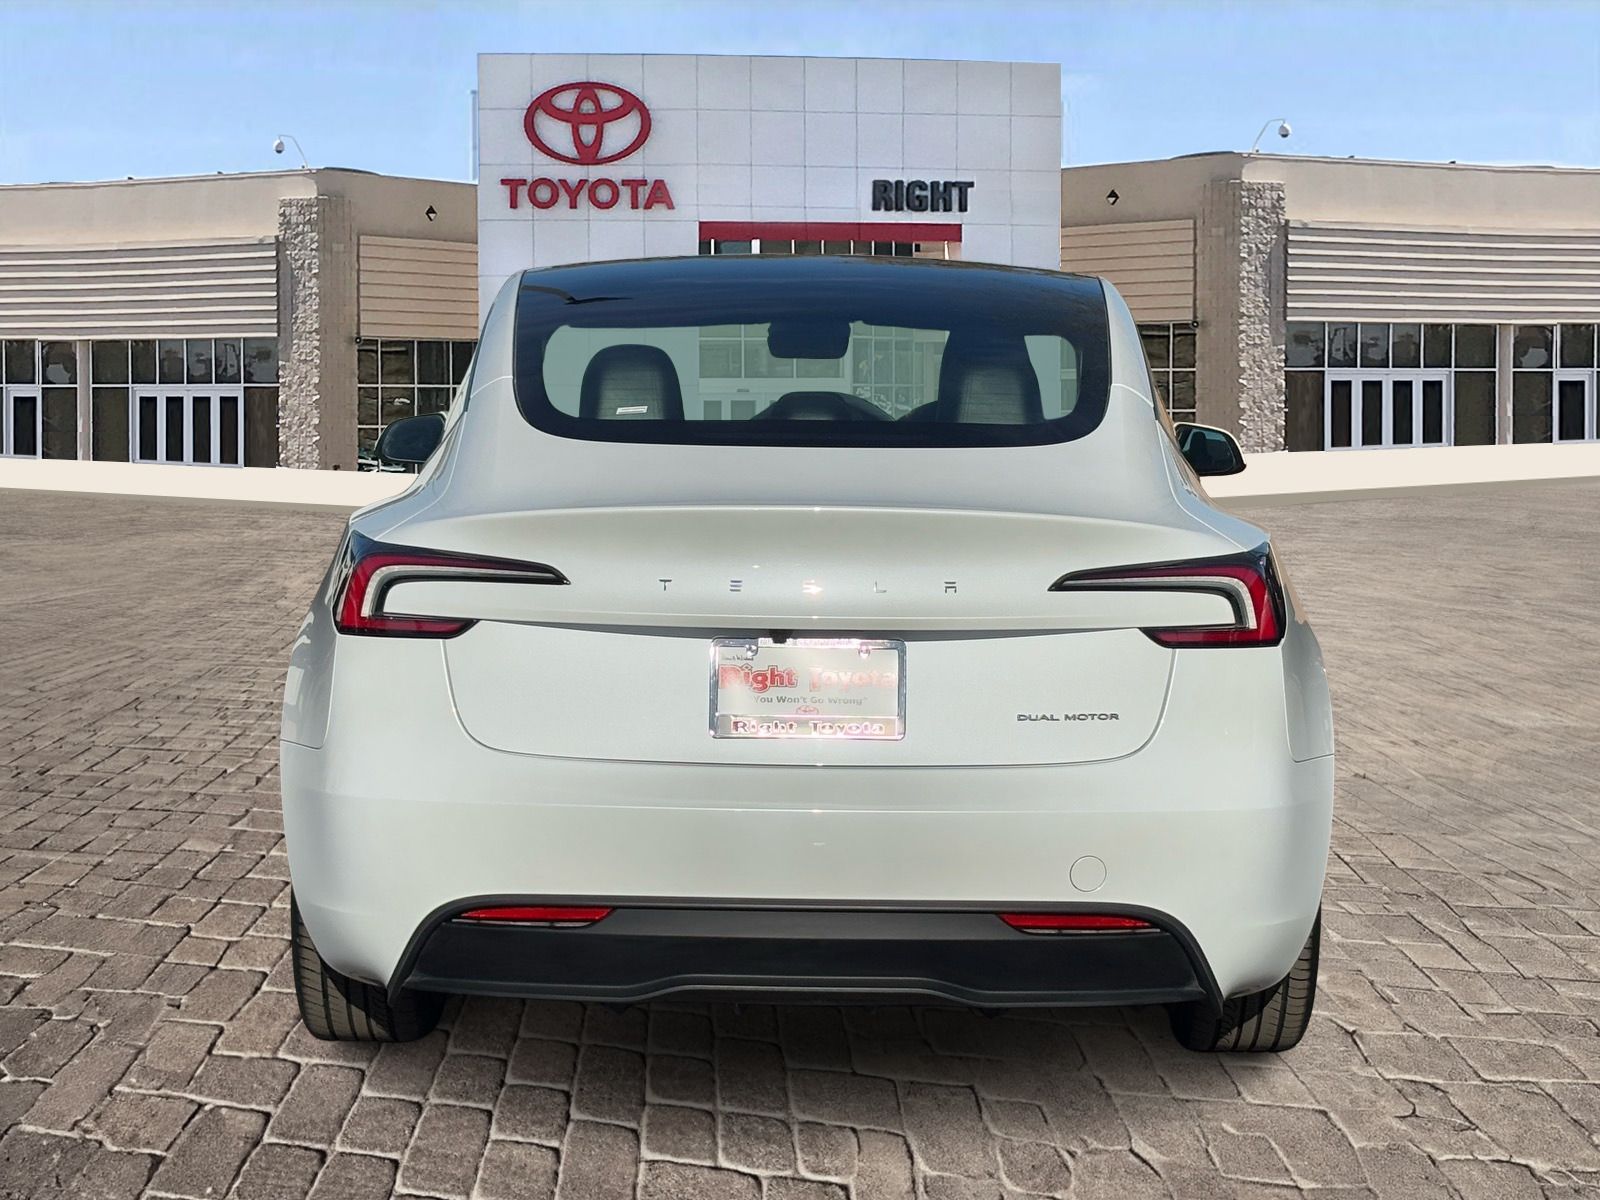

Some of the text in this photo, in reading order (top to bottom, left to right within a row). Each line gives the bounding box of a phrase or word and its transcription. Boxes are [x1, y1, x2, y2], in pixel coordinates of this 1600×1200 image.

[500, 178, 675, 210] TOYOTA
[871, 179, 975, 213] RIGHT
[718, 663, 898, 694] Right Toyota
[753, 695, 774, 705] You
[776, 695, 808, 705] Won't
[811, 696, 825, 705] Go
[731, 719, 886, 736] Right Toyota
[1017, 713, 1120, 722] DUAL MOTOR
